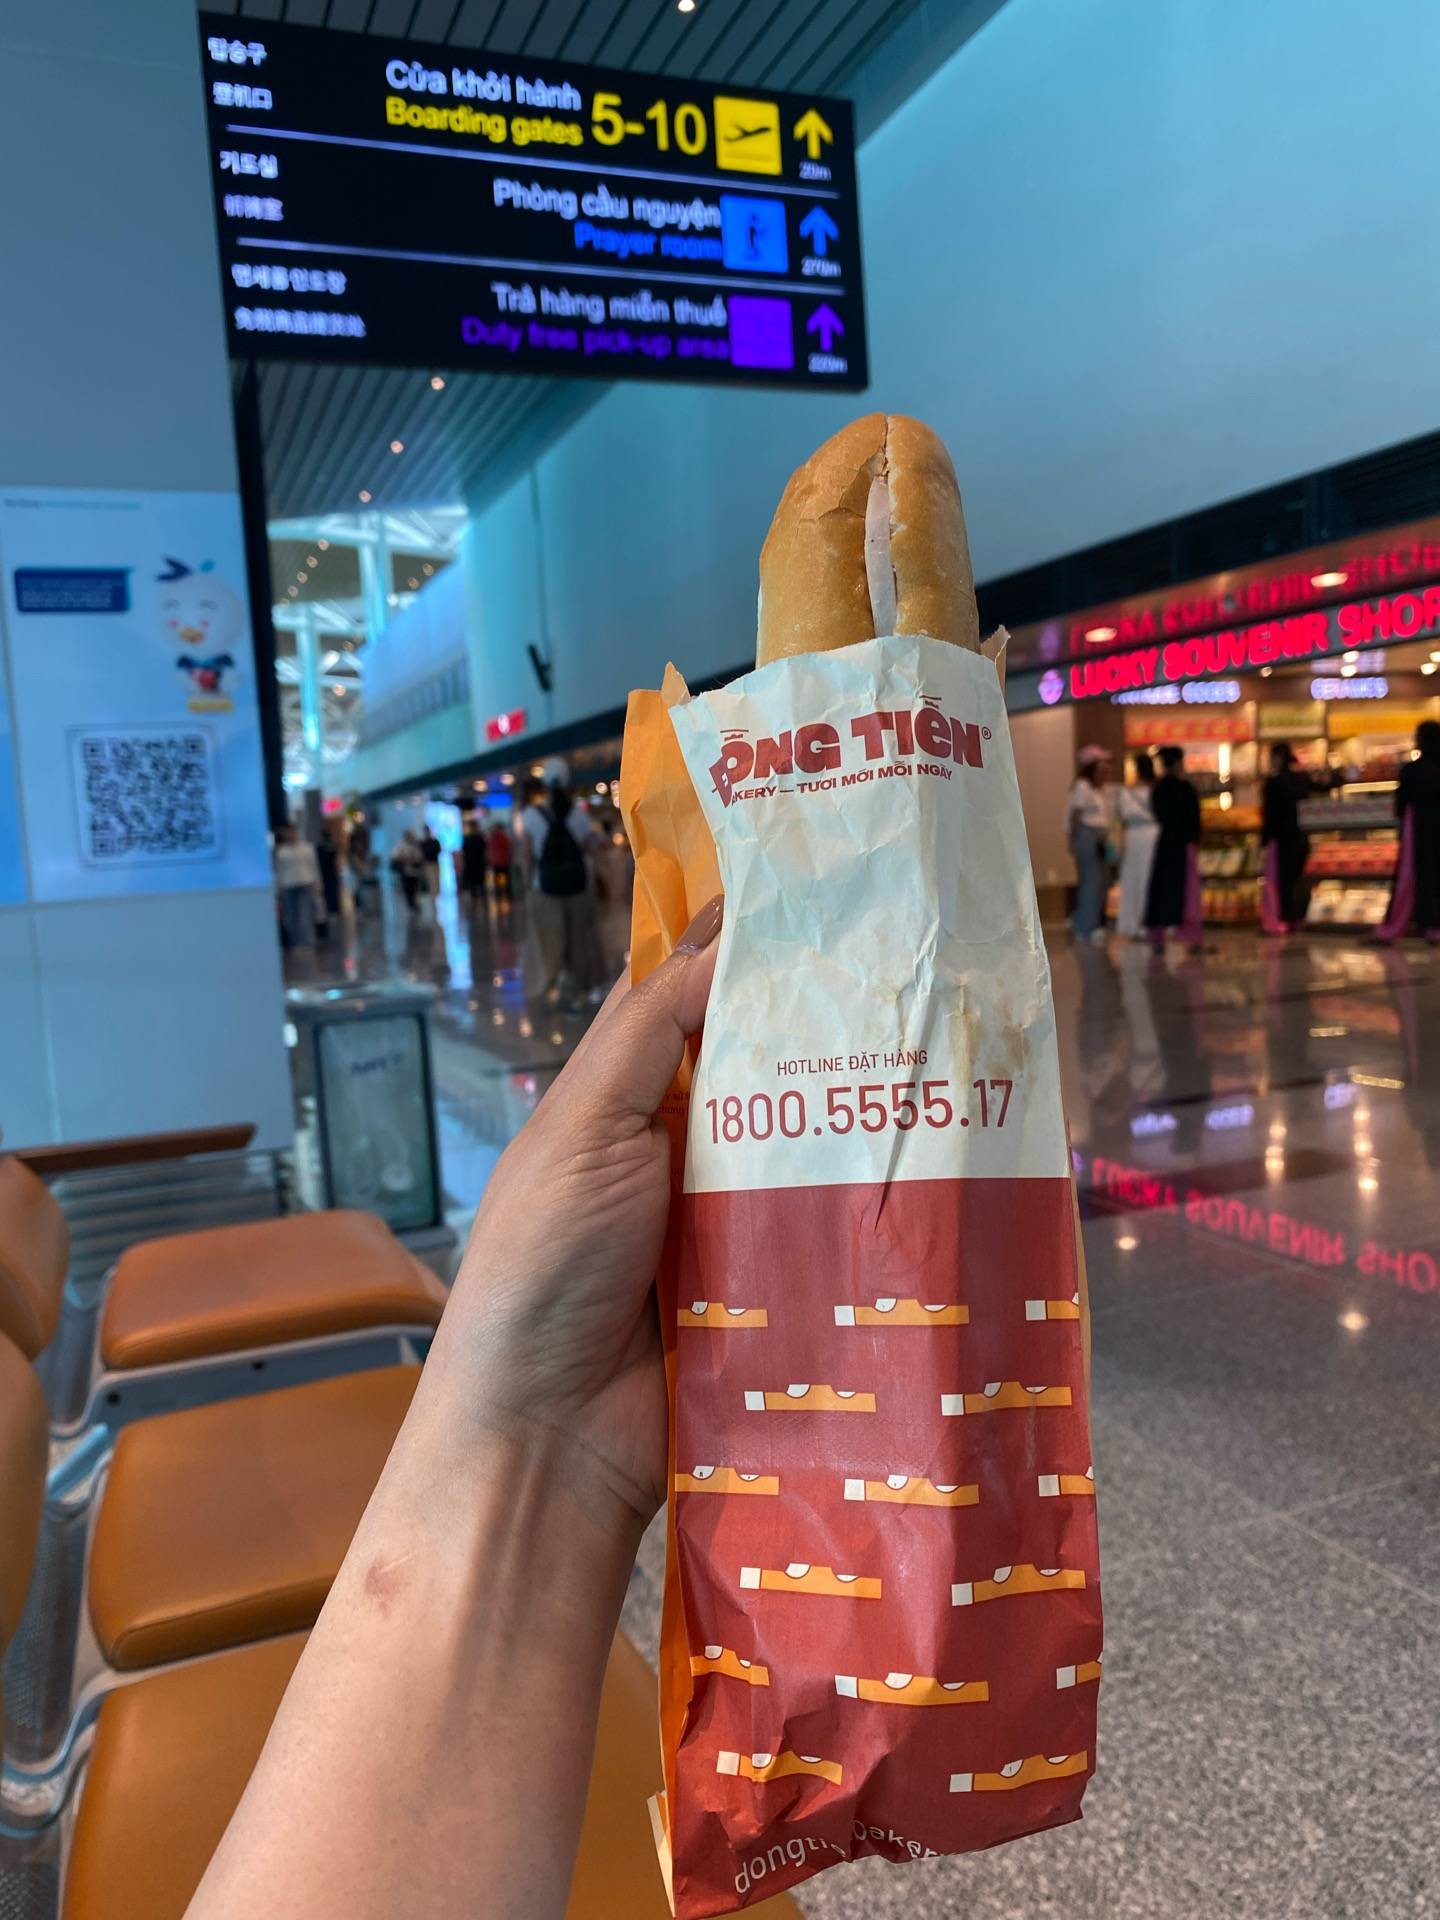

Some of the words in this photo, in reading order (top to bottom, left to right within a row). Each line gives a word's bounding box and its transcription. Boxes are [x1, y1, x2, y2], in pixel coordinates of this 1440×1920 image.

[385, 59, 448, 94] Cửa
[516, 75, 582, 111] hành
[386, 96, 507, 143] Boarding
[511, 116, 583, 146] gates
[591, 91, 708, 156] 5-10
[493, 178, 578, 221] Phòng
[574, 220, 656, 259] Prayer
[660, 234, 722, 261] room
[461, 315, 522, 353] Duty
[527, 319, 579, 351] free
[1070, 647, 1158, 699] LUCKY
[1162, 612, 1329, 682] SOUVENIR
[1337, 585, 1440, 648] SHOP
[777, 1056, 844, 1076] HOTLINE
[848, 1051, 880, 1073] ĐẶT
[883, 1048, 929, 1067] HÀNG
[705, 1079, 1014, 1145] 1800.5555.17
